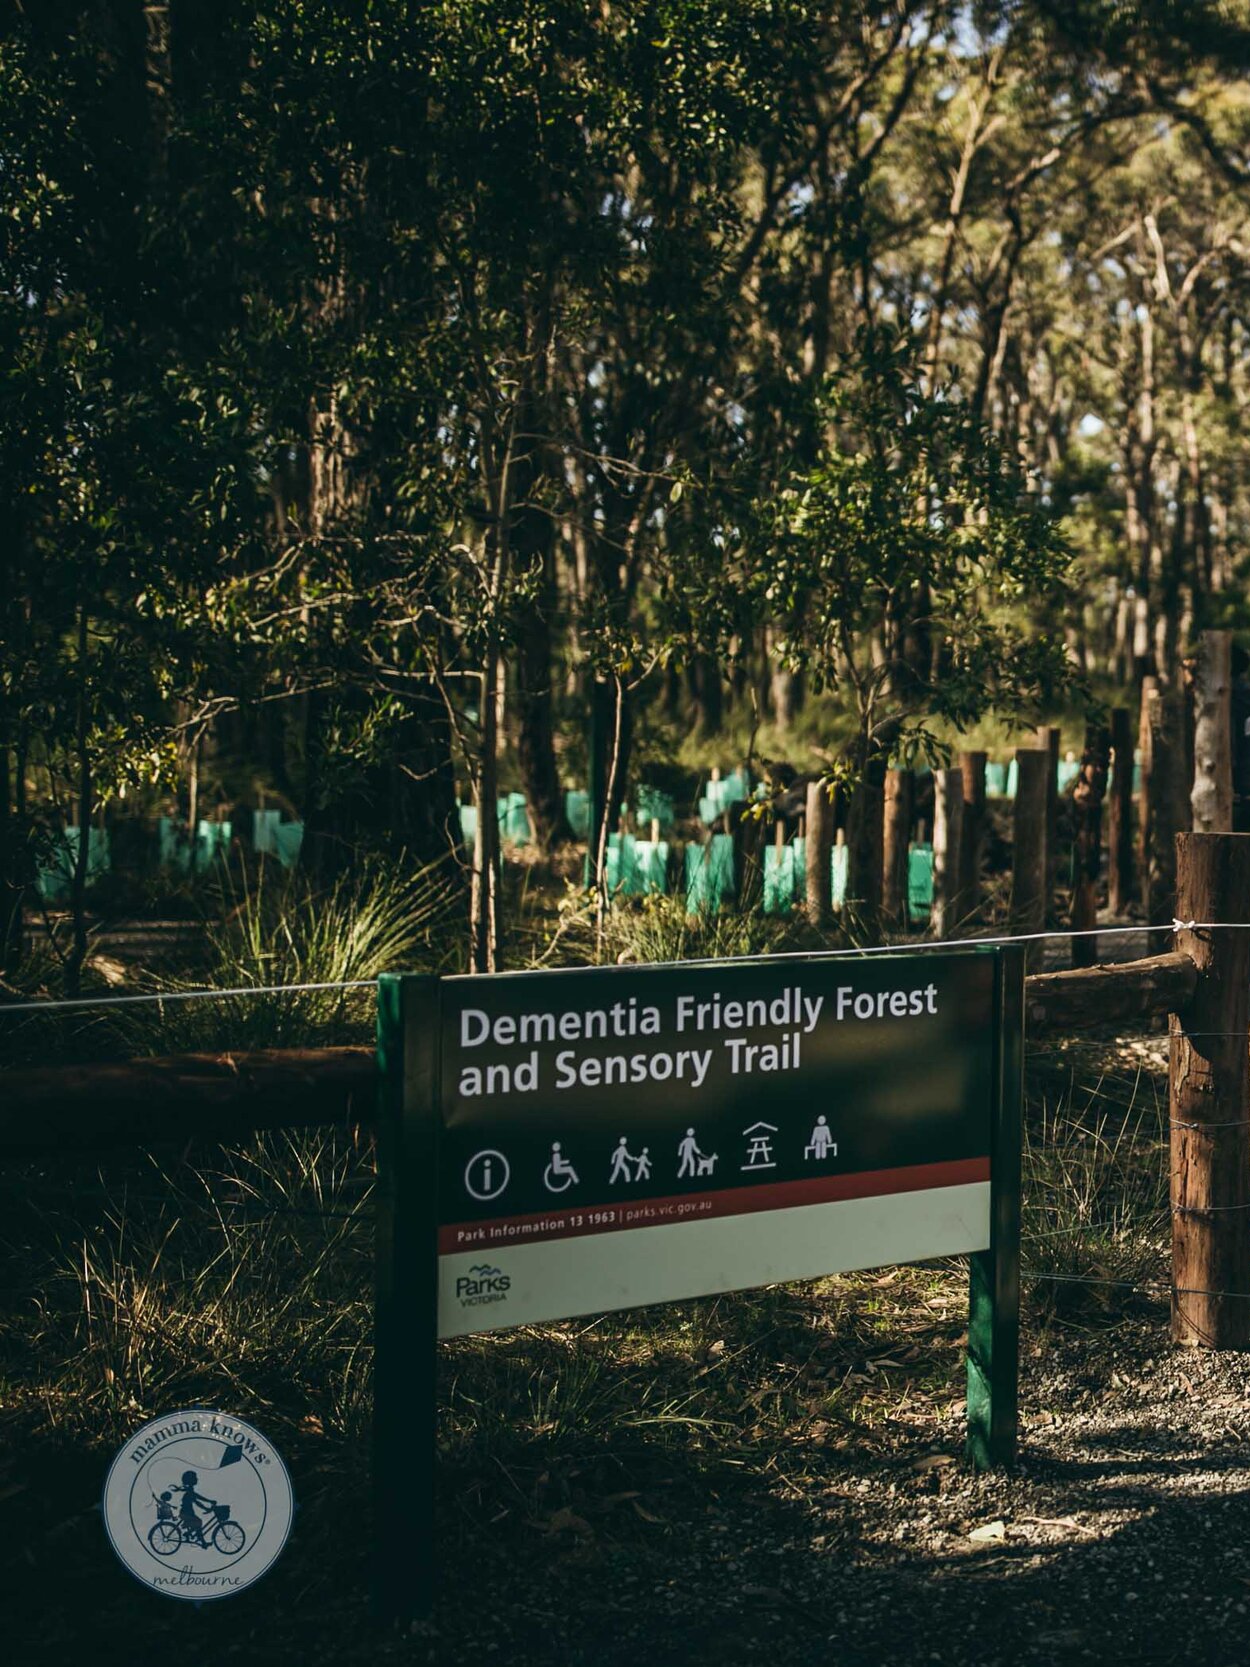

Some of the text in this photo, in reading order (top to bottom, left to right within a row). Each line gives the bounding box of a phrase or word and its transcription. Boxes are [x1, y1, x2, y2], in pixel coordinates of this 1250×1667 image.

[460, 983, 938, 1048] Dementia Friendly Forest
[458, 1033, 801, 1097] and Sensory Trail
[457, 1199, 712, 1242] Park Information 13 1963 parks.vic.gov.au
[456, 1274, 511, 1297] Parks
[460, 1292, 507, 1308] VICTORIA
